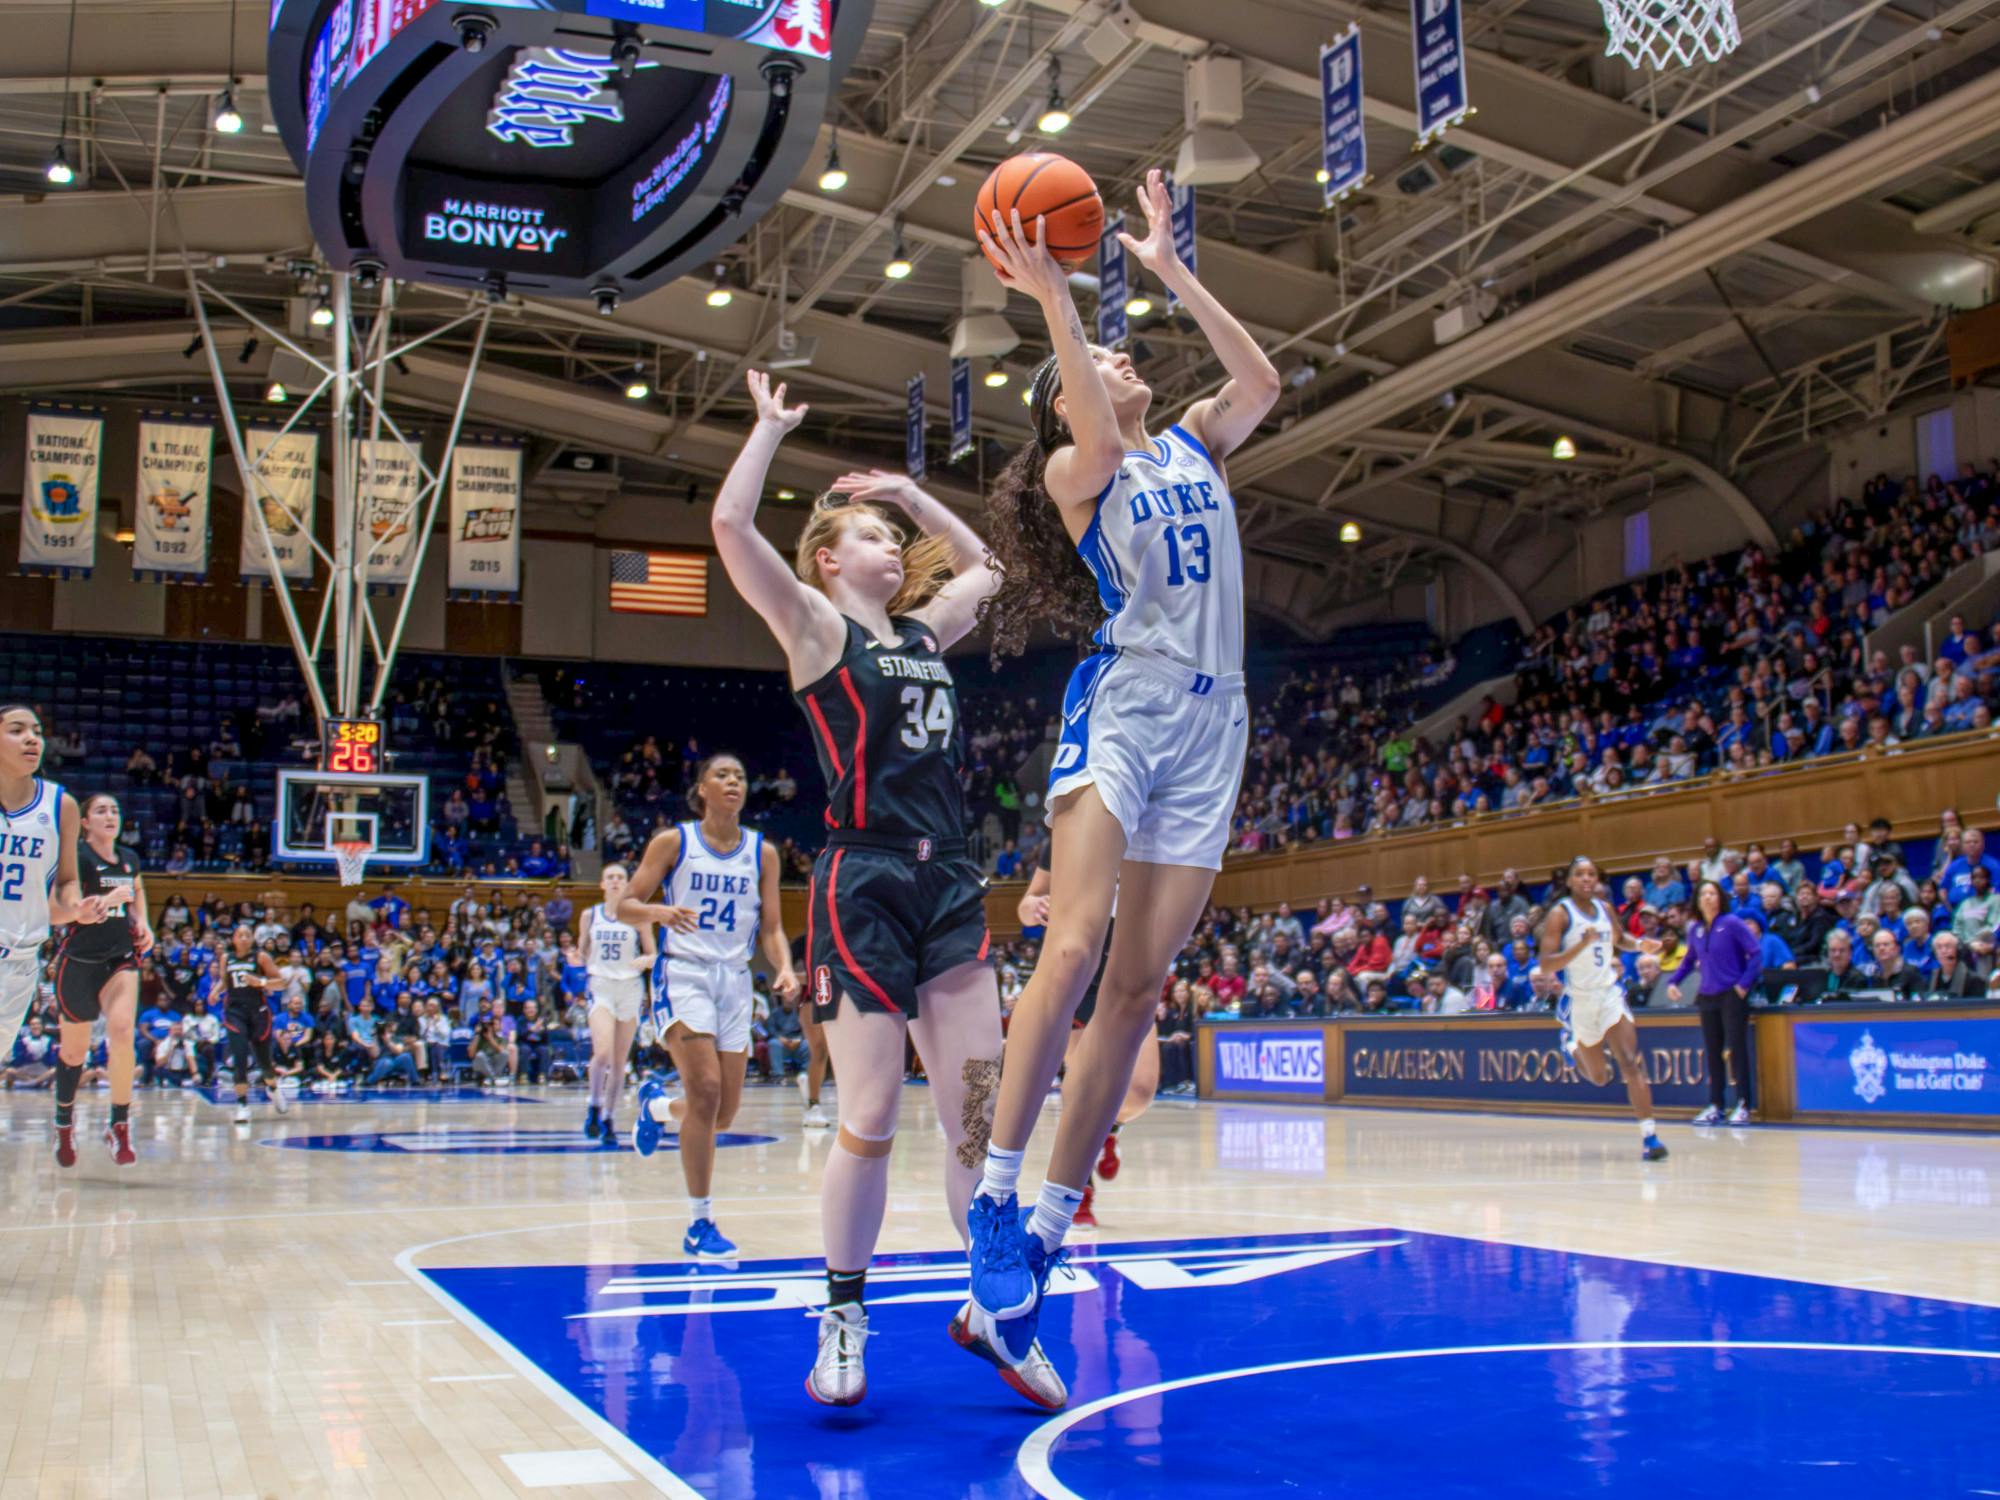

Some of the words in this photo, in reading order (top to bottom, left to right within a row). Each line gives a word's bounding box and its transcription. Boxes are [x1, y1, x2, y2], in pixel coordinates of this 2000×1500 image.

[443, 199, 545, 225] MARRIOTT
[425, 213, 561, 253] BONVOY
[150, 442, 200, 457] NTIONAL
[463, 465, 509, 479] NATIONAL
[457, 480, 517, 495] CHAMPIONS
[1130, 481, 1219, 525] DUKE
[43, 534, 75, 547] 1991
[155, 540, 187, 553] 1992
[470, 559, 501, 573] 2015
[1164, 524, 1211, 586] 13
[877, 655, 954, 686] STANFOR
[900, 686, 954, 749] 34
[339, 723, 379, 743] 5:20
[331, 742, 371, 771] 26
[0, 834, 45, 859] KE
[0, 863, 25, 901] 2
[690, 872, 750, 895] DUKE
[700, 898, 736, 932] 24
[596, 930, 628, 942] DUKE
[601, 943, 621, 961] 35
[1593, 946, 1604, 967] 5
[1265, 1045, 1321, 1078] NEWS
[1353, 1048, 1465, 1081] CAMERON
[1603, 1048, 1737, 1086] SADIU
[1953, 1053, 1986, 1069] Duke
[1953, 1073, 1985, 1090] Club
